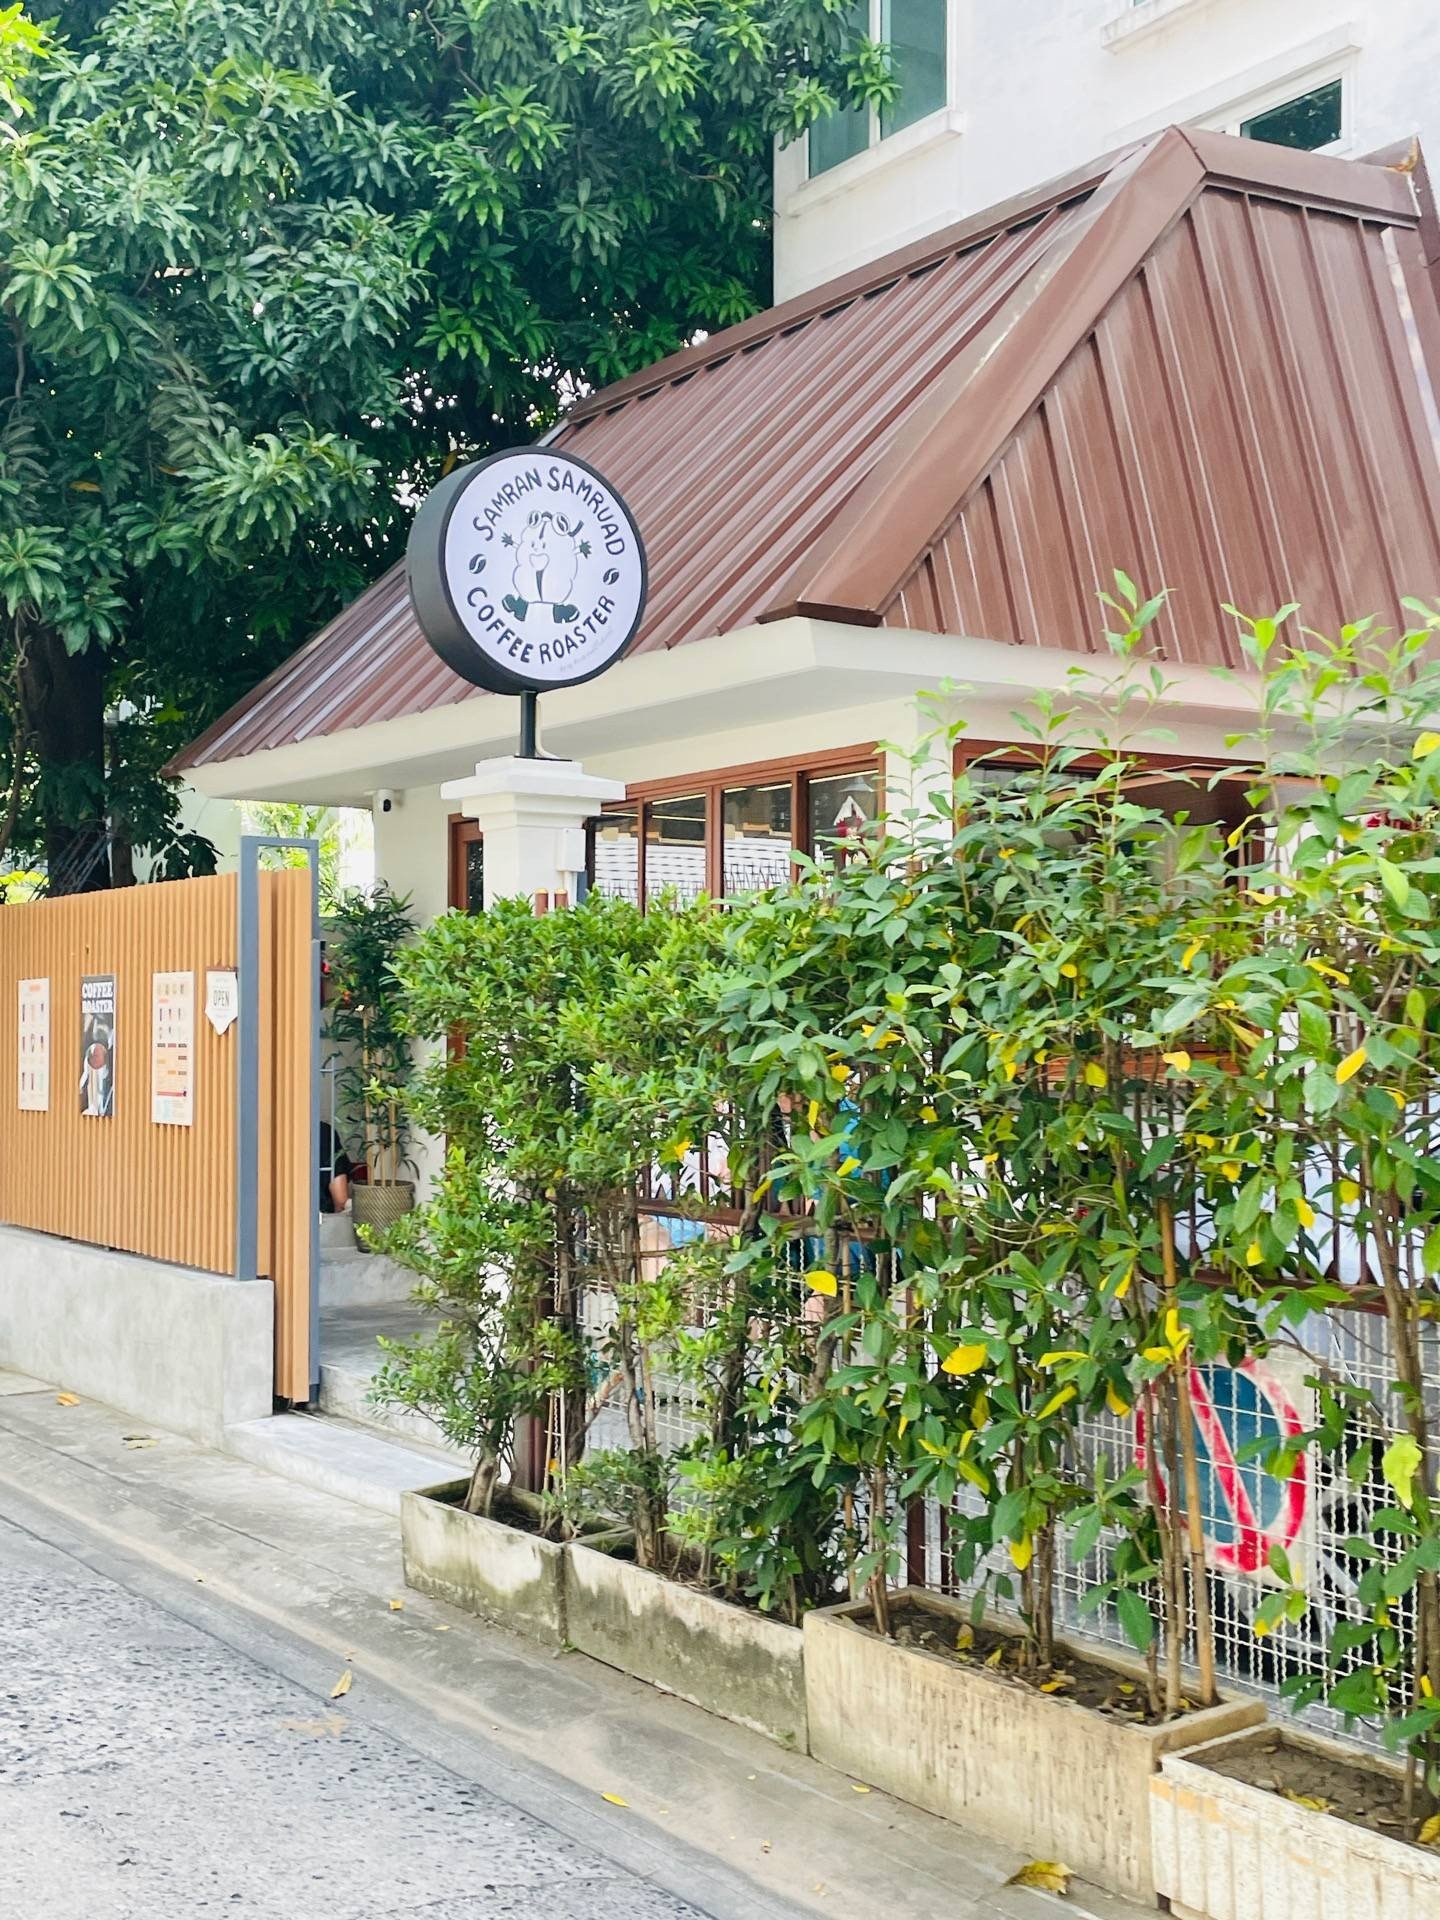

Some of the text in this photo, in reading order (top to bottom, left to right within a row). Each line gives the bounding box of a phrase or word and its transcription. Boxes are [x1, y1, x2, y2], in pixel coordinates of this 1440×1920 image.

[473, 466, 626, 556] SAMRAN SAMRUAD
[467, 586, 534, 664] COFFEE
[539, 595, 616, 665] ROASTER
[82, 981, 113, 999] COFFEE
[213, 990, 230, 1007] OPEN
